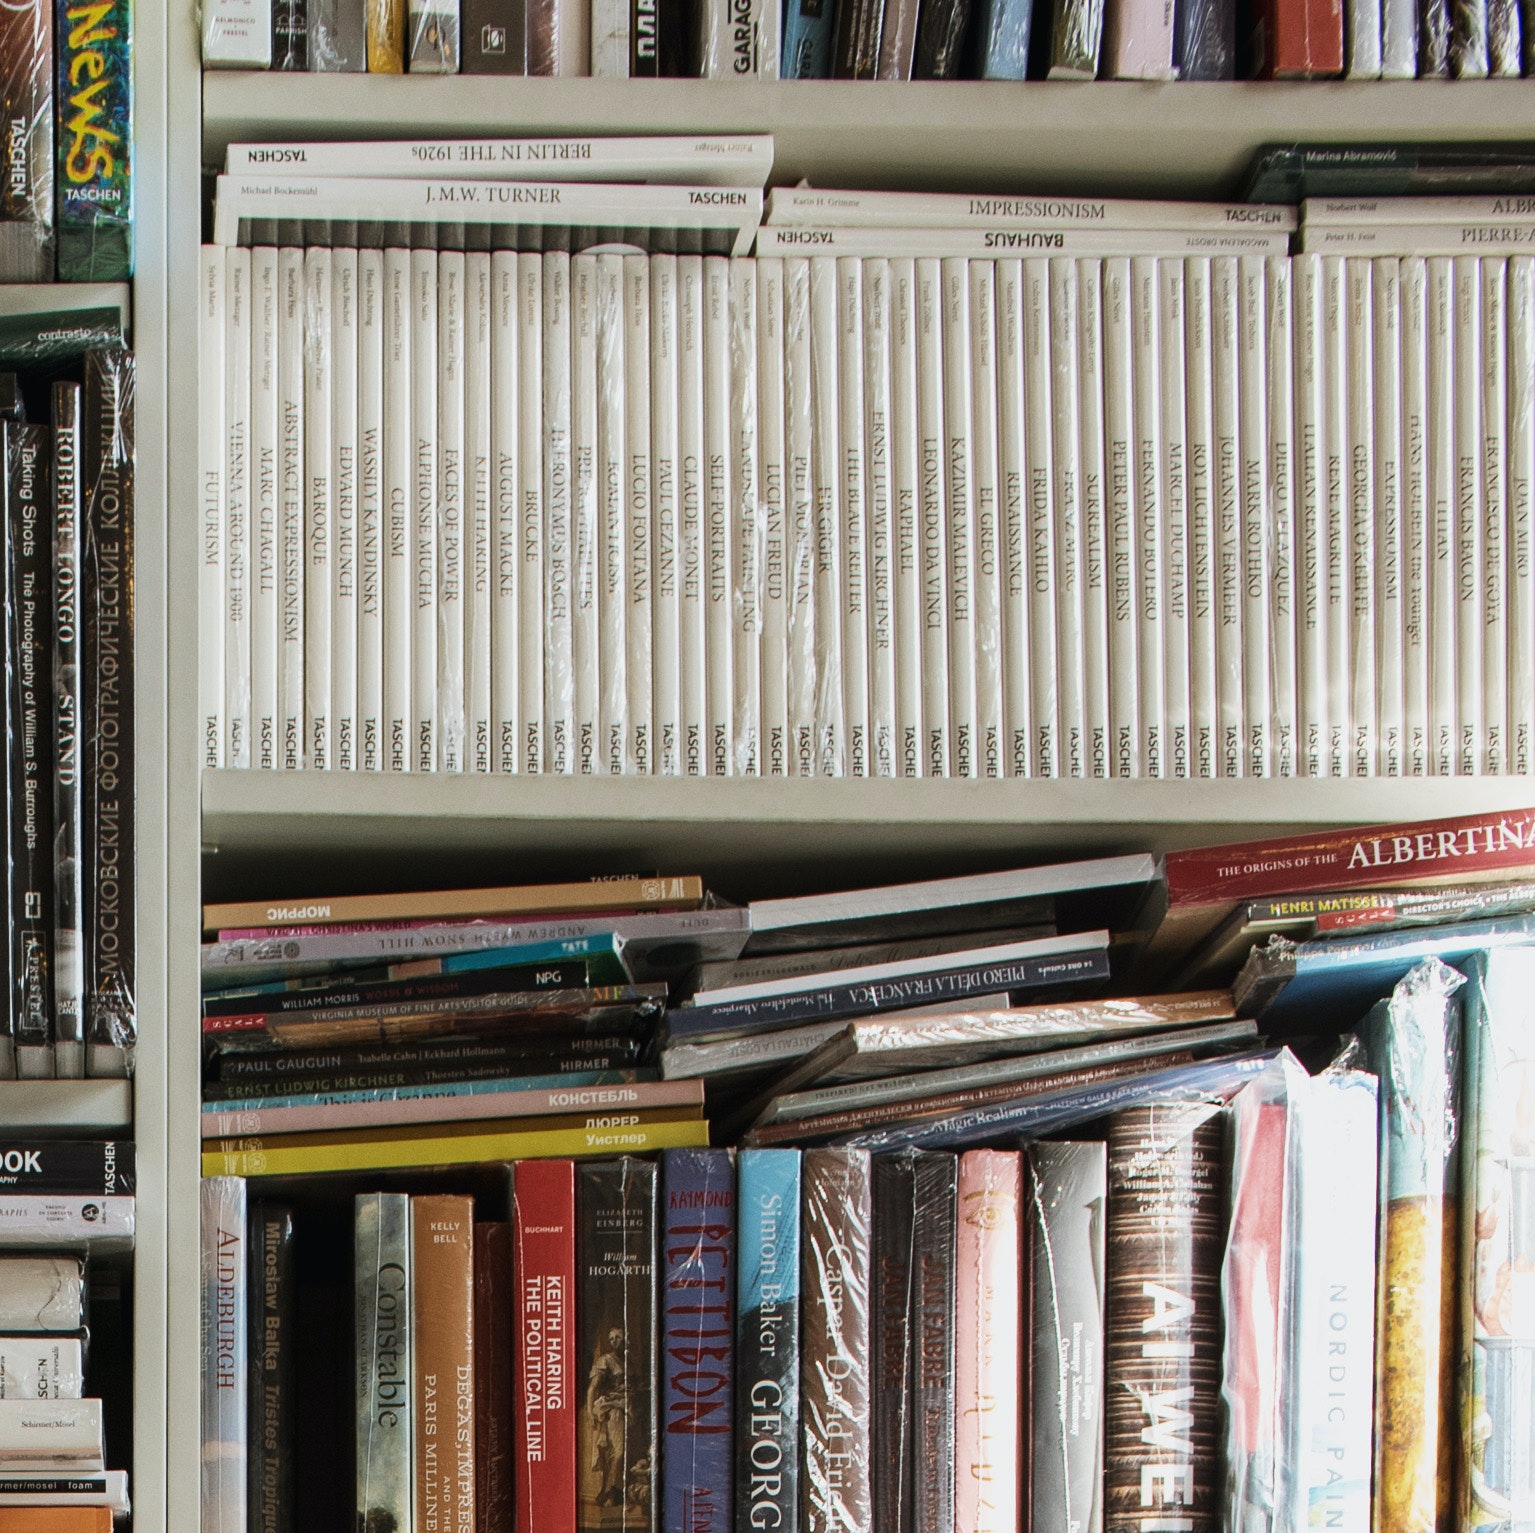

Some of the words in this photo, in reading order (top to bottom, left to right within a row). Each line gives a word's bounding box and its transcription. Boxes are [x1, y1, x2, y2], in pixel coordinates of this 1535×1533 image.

[248, 150, 308, 162] TASCHEN
[412, 145, 451, 161] 1920s
[459, 144, 496, 161] THE
[502, 144, 522, 160] IN
[527, 143, 591, 160] BERLIN
[65, 188, 121, 202] TASCHEN
[483, 187, 561, 204] TURNER
[968, 199, 1105, 220] IMPRESSIONISM
[983, 232, 1064, 249] BAUHAUS
[363, 428, 377, 503] WASSILY
[57, 427, 74, 537] ROBERT
[390, 487, 404, 558] CUBISM
[364, 507, 378, 617] KANDINSKY
[57, 550, 75, 644] LONGO
[265, 904, 331, 921] МОРРИС
[548, 1090, 638, 1107] КОНСТЕБЛЬ
[585, 1130, 647, 1146] Уистлер
[546, 1274, 561, 1333] KEITH
[1141, 1283, 1195, 1357] AI
[546, 1338, 561, 1409] HARING
